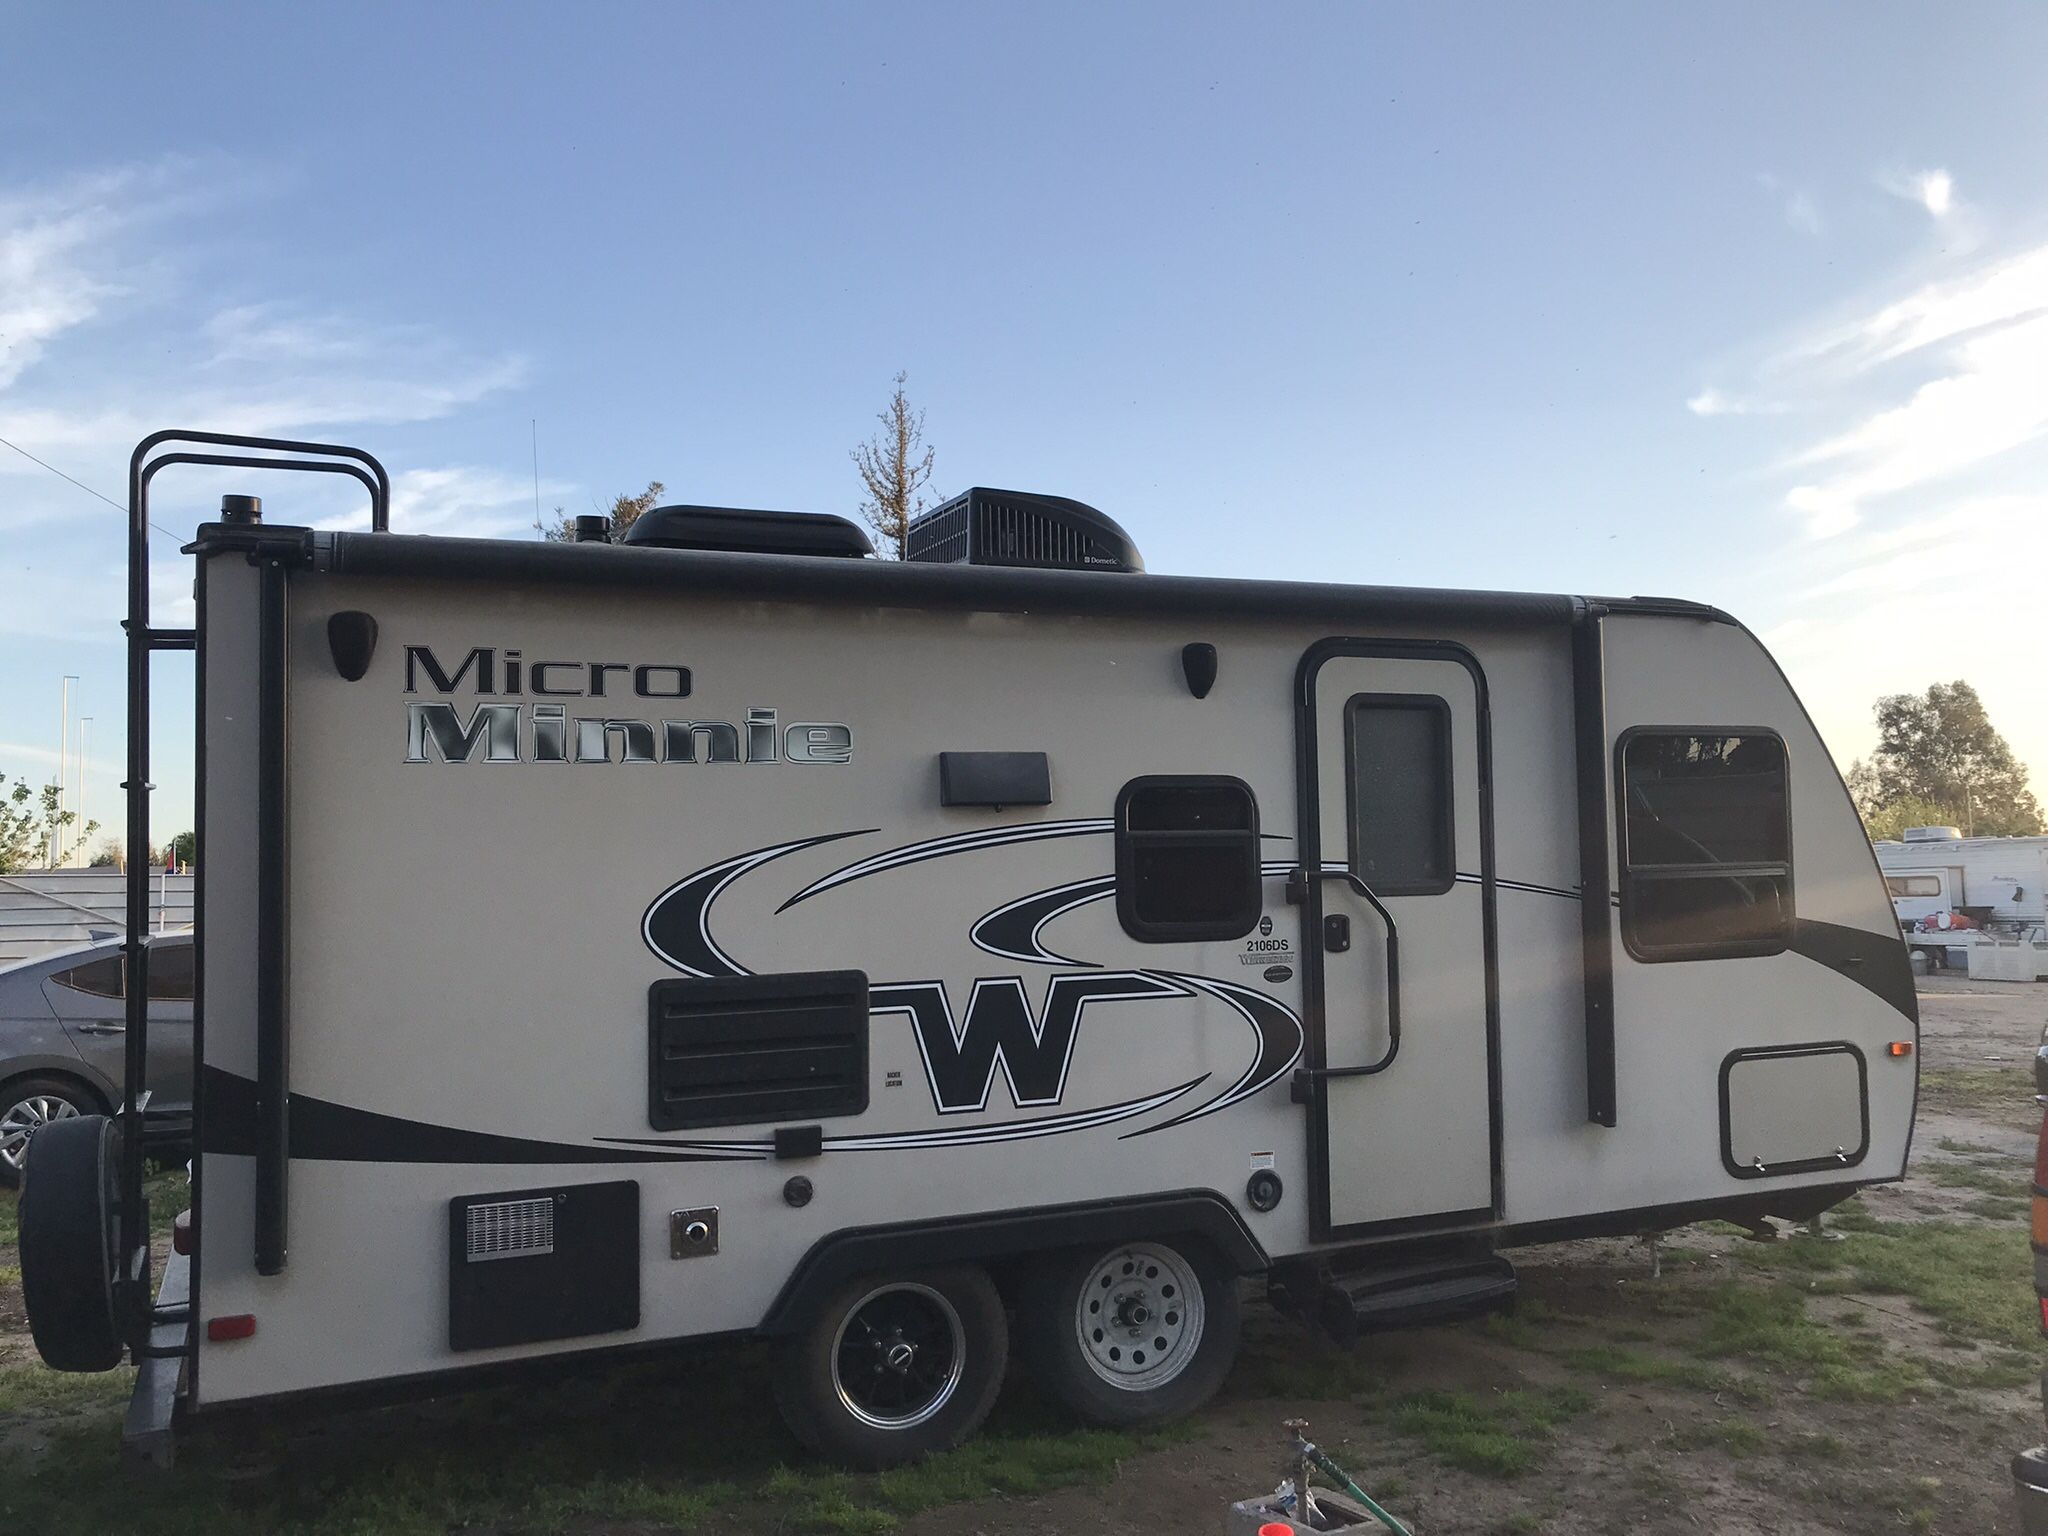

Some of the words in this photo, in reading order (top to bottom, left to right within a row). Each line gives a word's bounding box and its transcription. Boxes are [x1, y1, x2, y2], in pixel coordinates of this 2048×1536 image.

[1091, 556, 1117, 565] Dometic
[403, 644, 694, 699] Micro
[403, 701, 854, 765] Minnie
[1246, 939, 1289, 952] 2106DS
[897, 972, 1095, 1116] W
